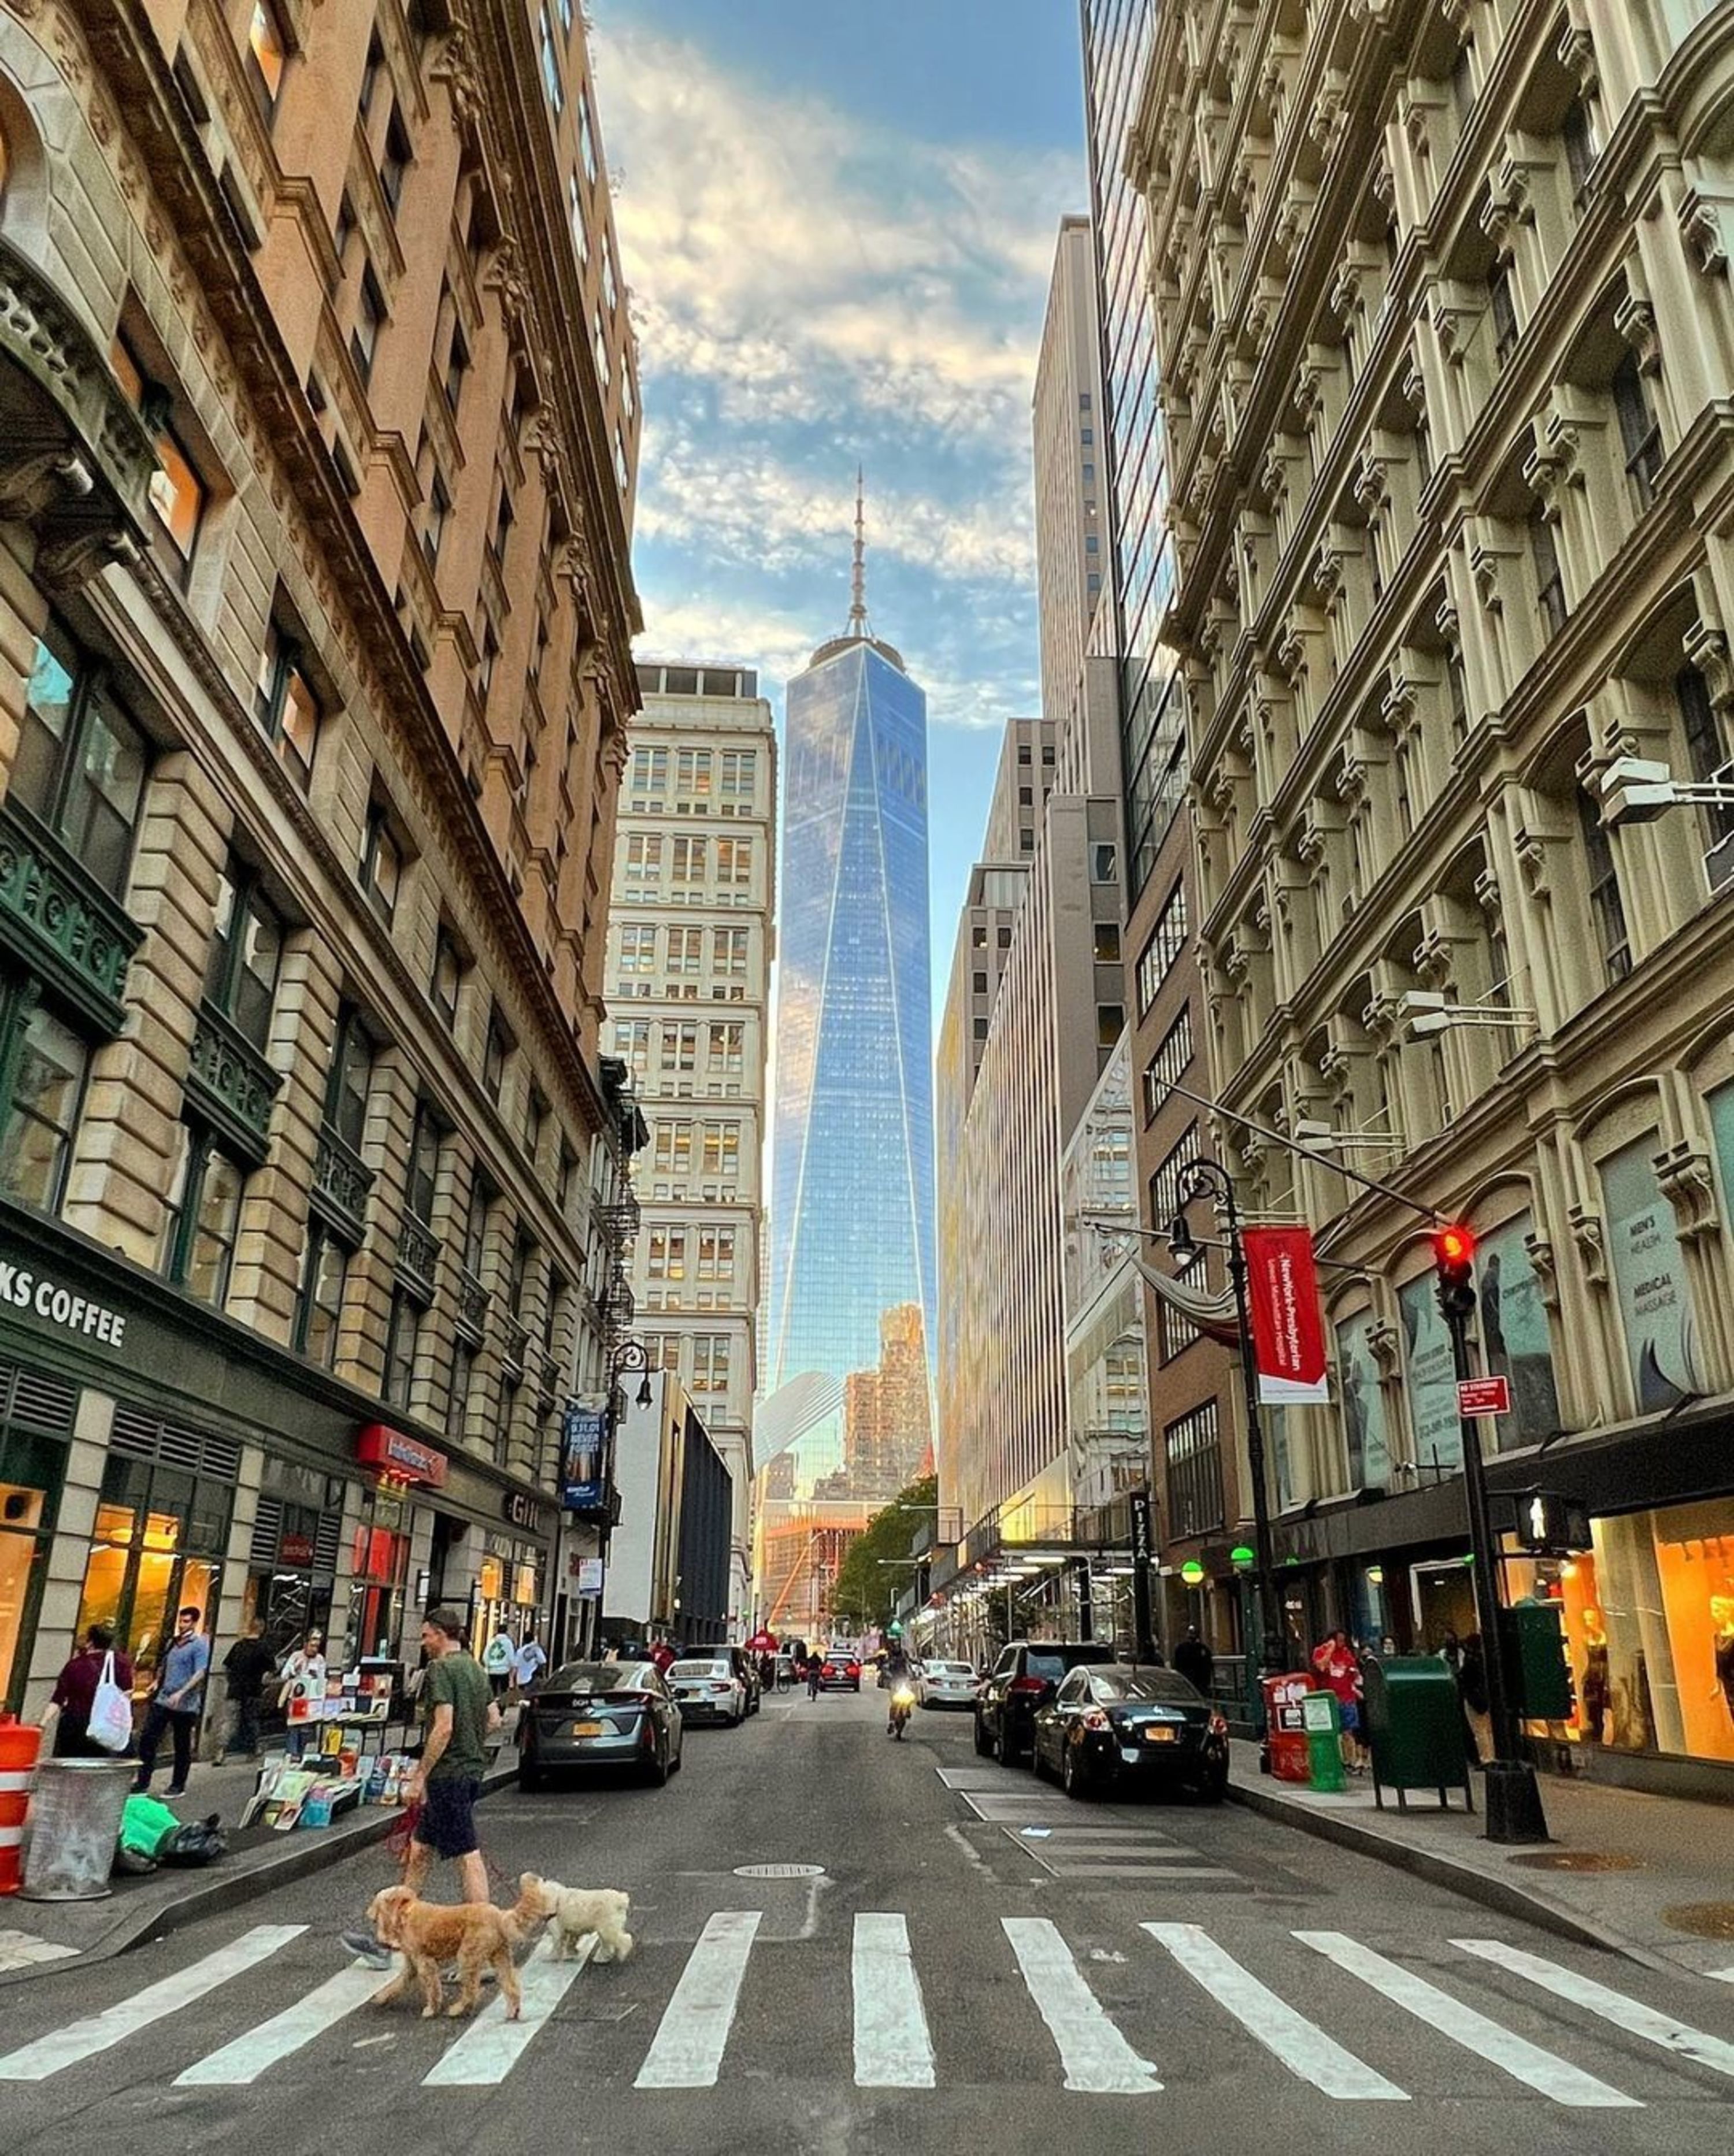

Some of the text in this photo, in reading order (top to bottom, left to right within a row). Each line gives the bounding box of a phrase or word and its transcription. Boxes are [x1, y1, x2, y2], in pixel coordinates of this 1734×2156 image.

[1634, 1272, 1672, 1298] MEDICAL
[35, 1282, 126, 1348] COFFEE
[1281, 1259, 1301, 1371] NewYork-Presbyterian
[1276, 1331, 1287, 1366] Hospital
[1135, 1500, 1148, 1558] PIZZA
